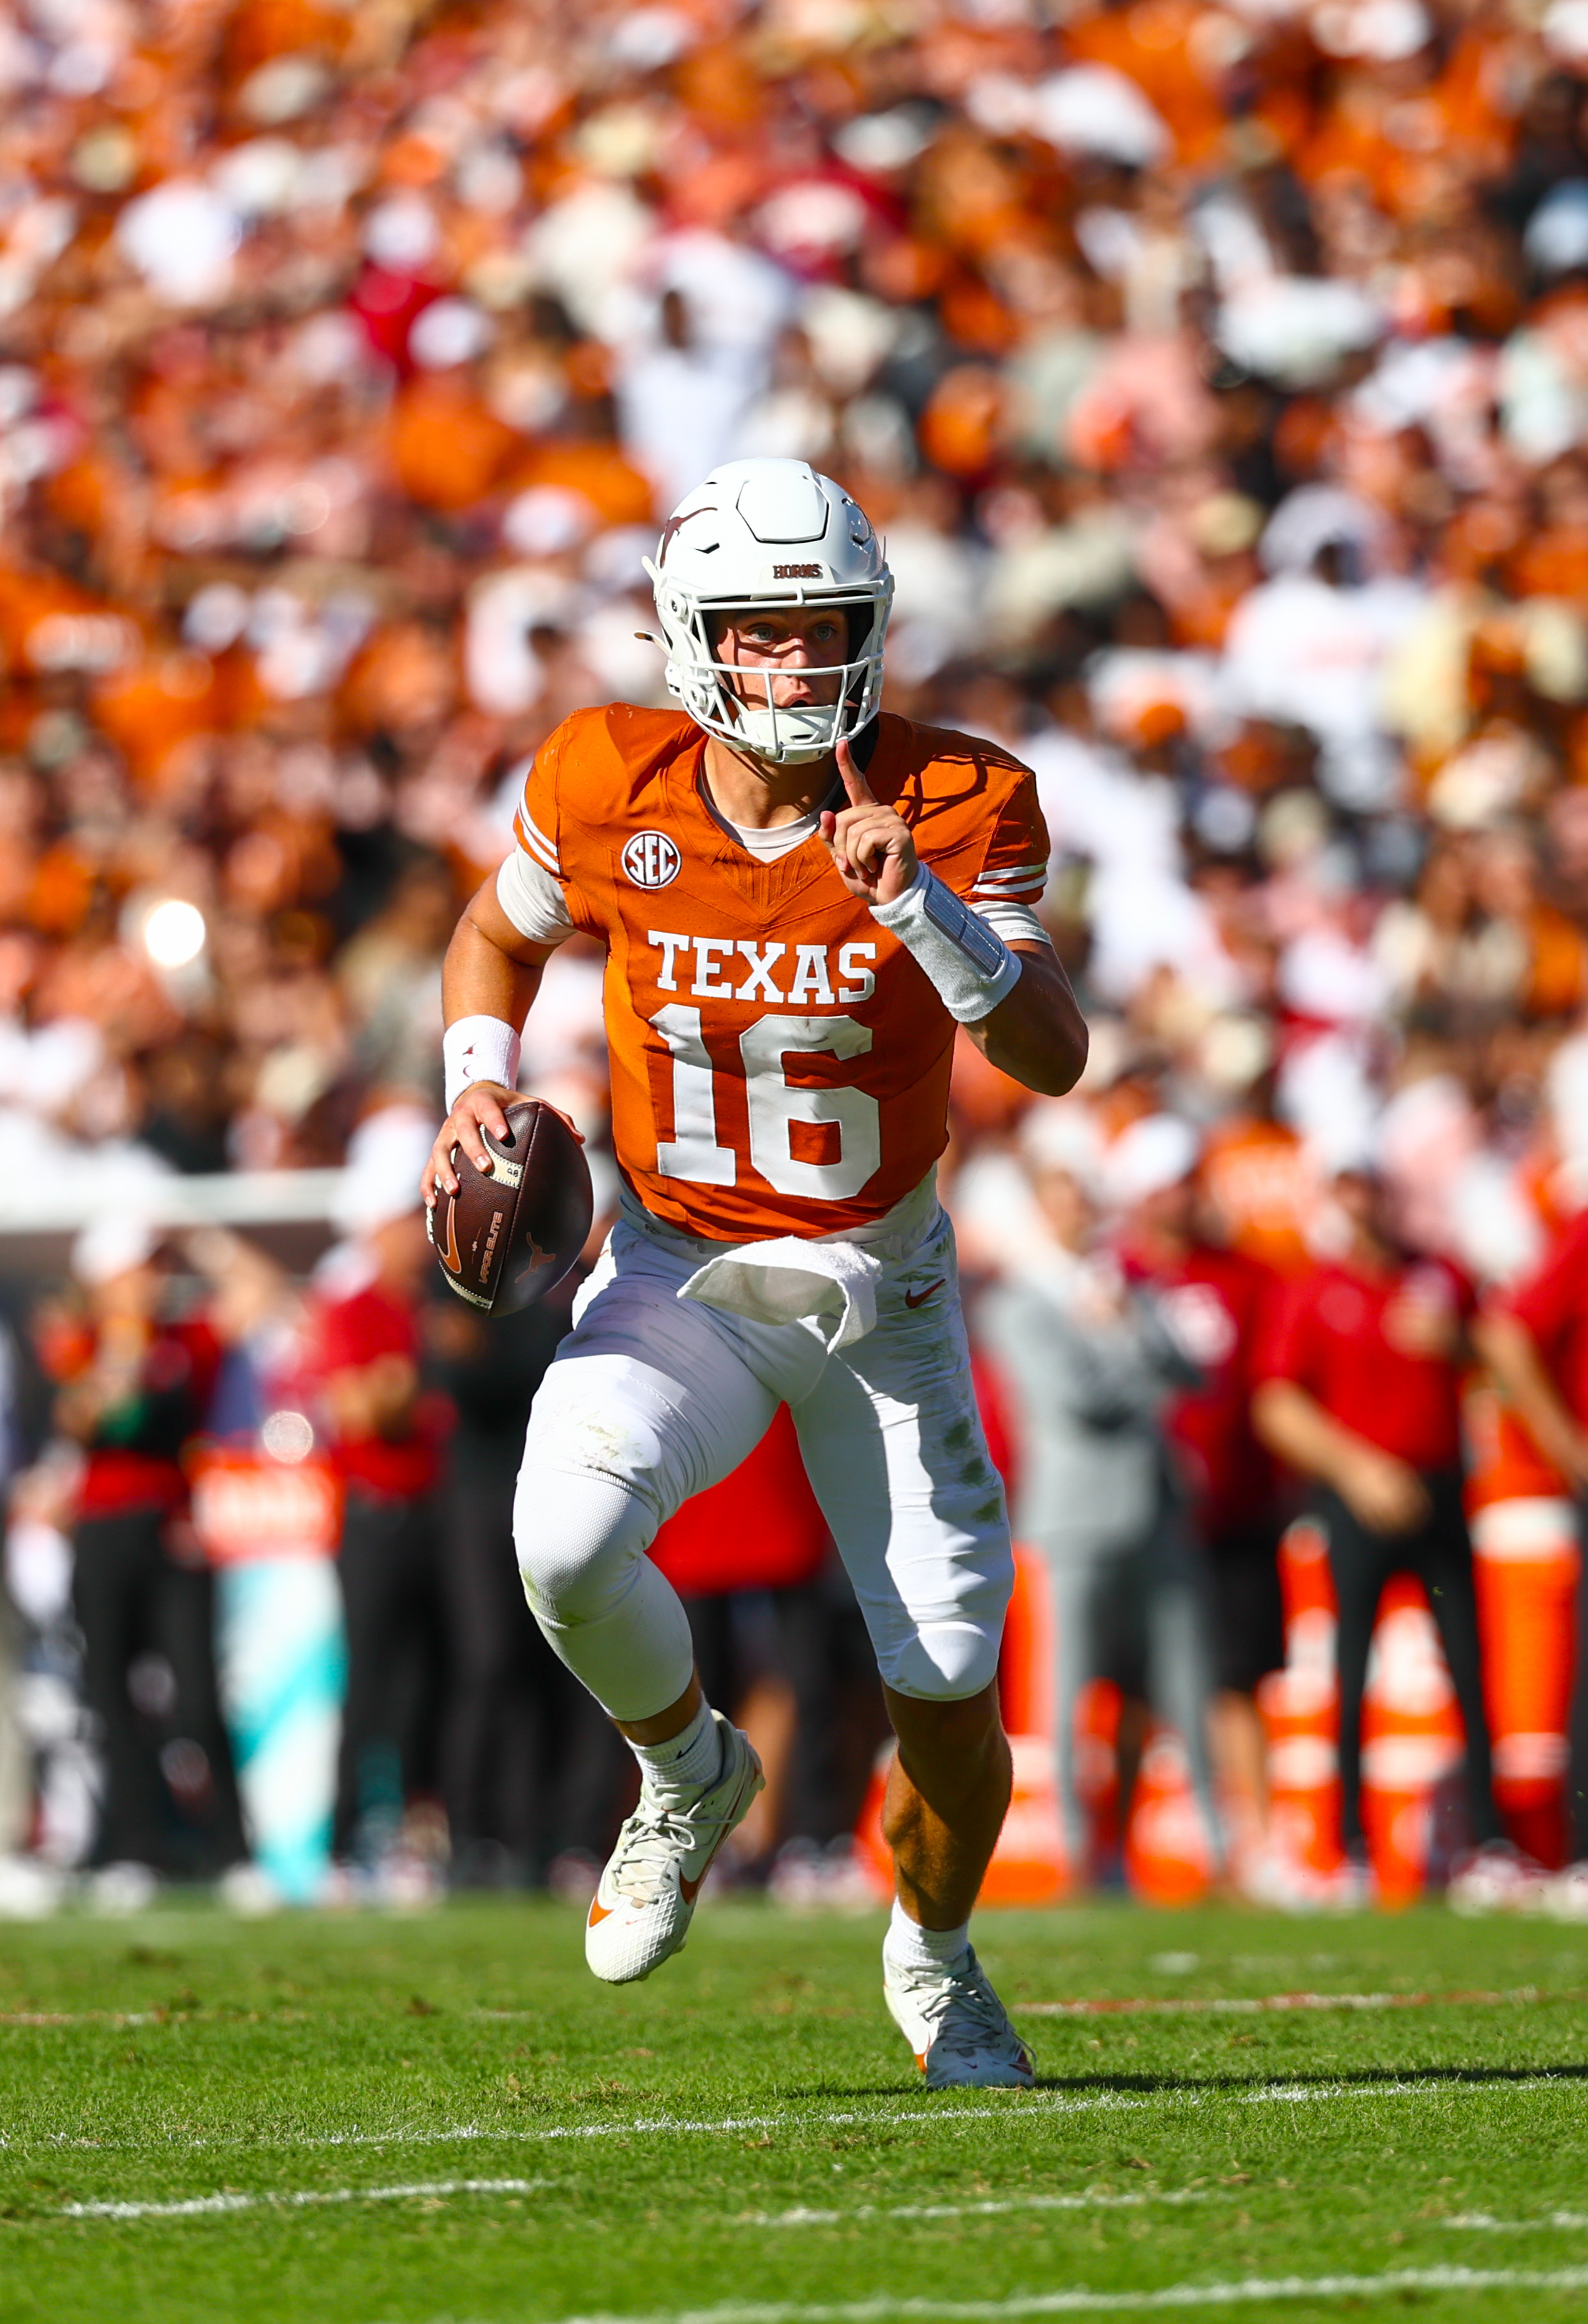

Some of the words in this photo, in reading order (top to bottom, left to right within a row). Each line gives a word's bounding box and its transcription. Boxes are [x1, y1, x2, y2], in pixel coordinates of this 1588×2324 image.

[772, 563, 822, 578] HORNS
[627, 835, 675, 884] SEC
[647, 929, 876, 1004] TEXAS
[648, 1003, 881, 1201] 16
[478, 1249, 493, 1284] VAPOR
[486, 1211, 503, 1250] ELITE
